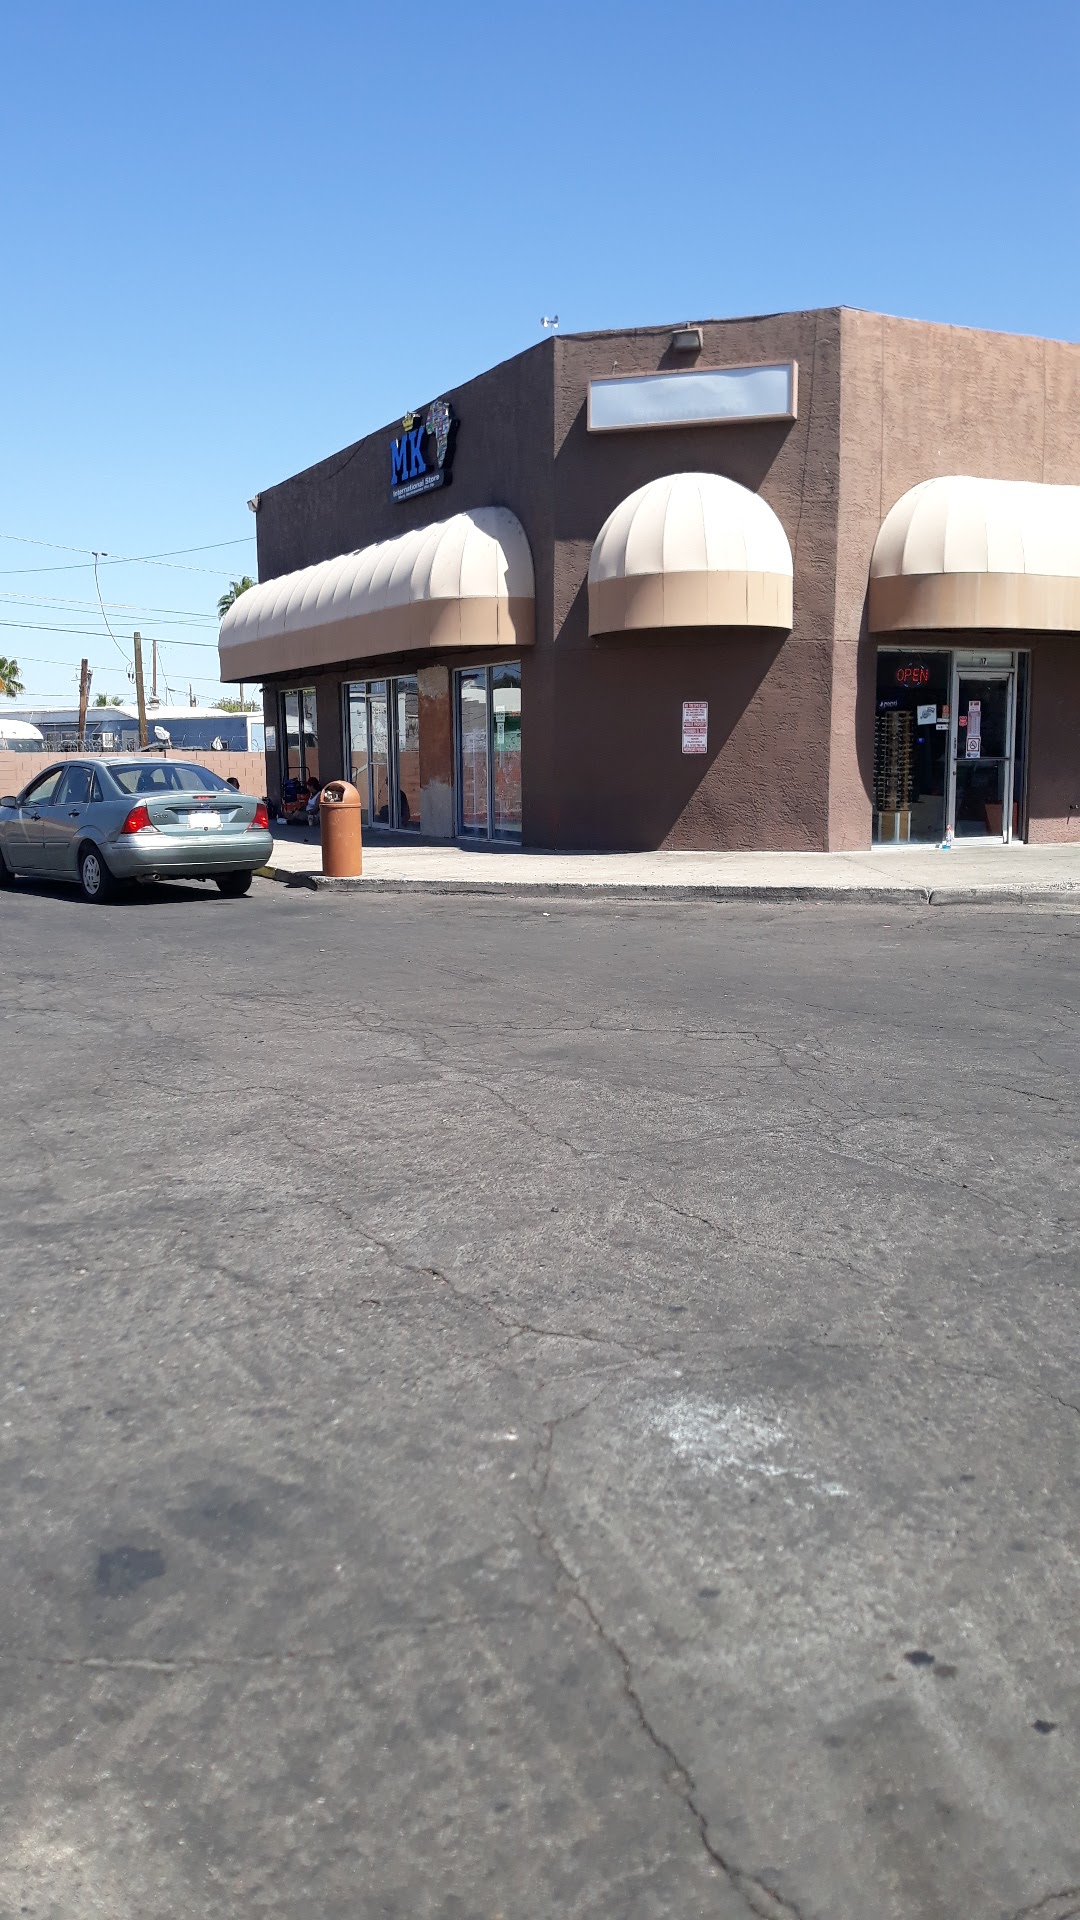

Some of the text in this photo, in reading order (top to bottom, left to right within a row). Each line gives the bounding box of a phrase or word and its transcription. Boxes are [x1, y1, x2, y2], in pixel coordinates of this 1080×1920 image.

[390, 425, 426, 485] MK
[393, 479, 425, 498] International
[425, 474, 440, 485] Store
[897, 668, 929, 683] OPEN
